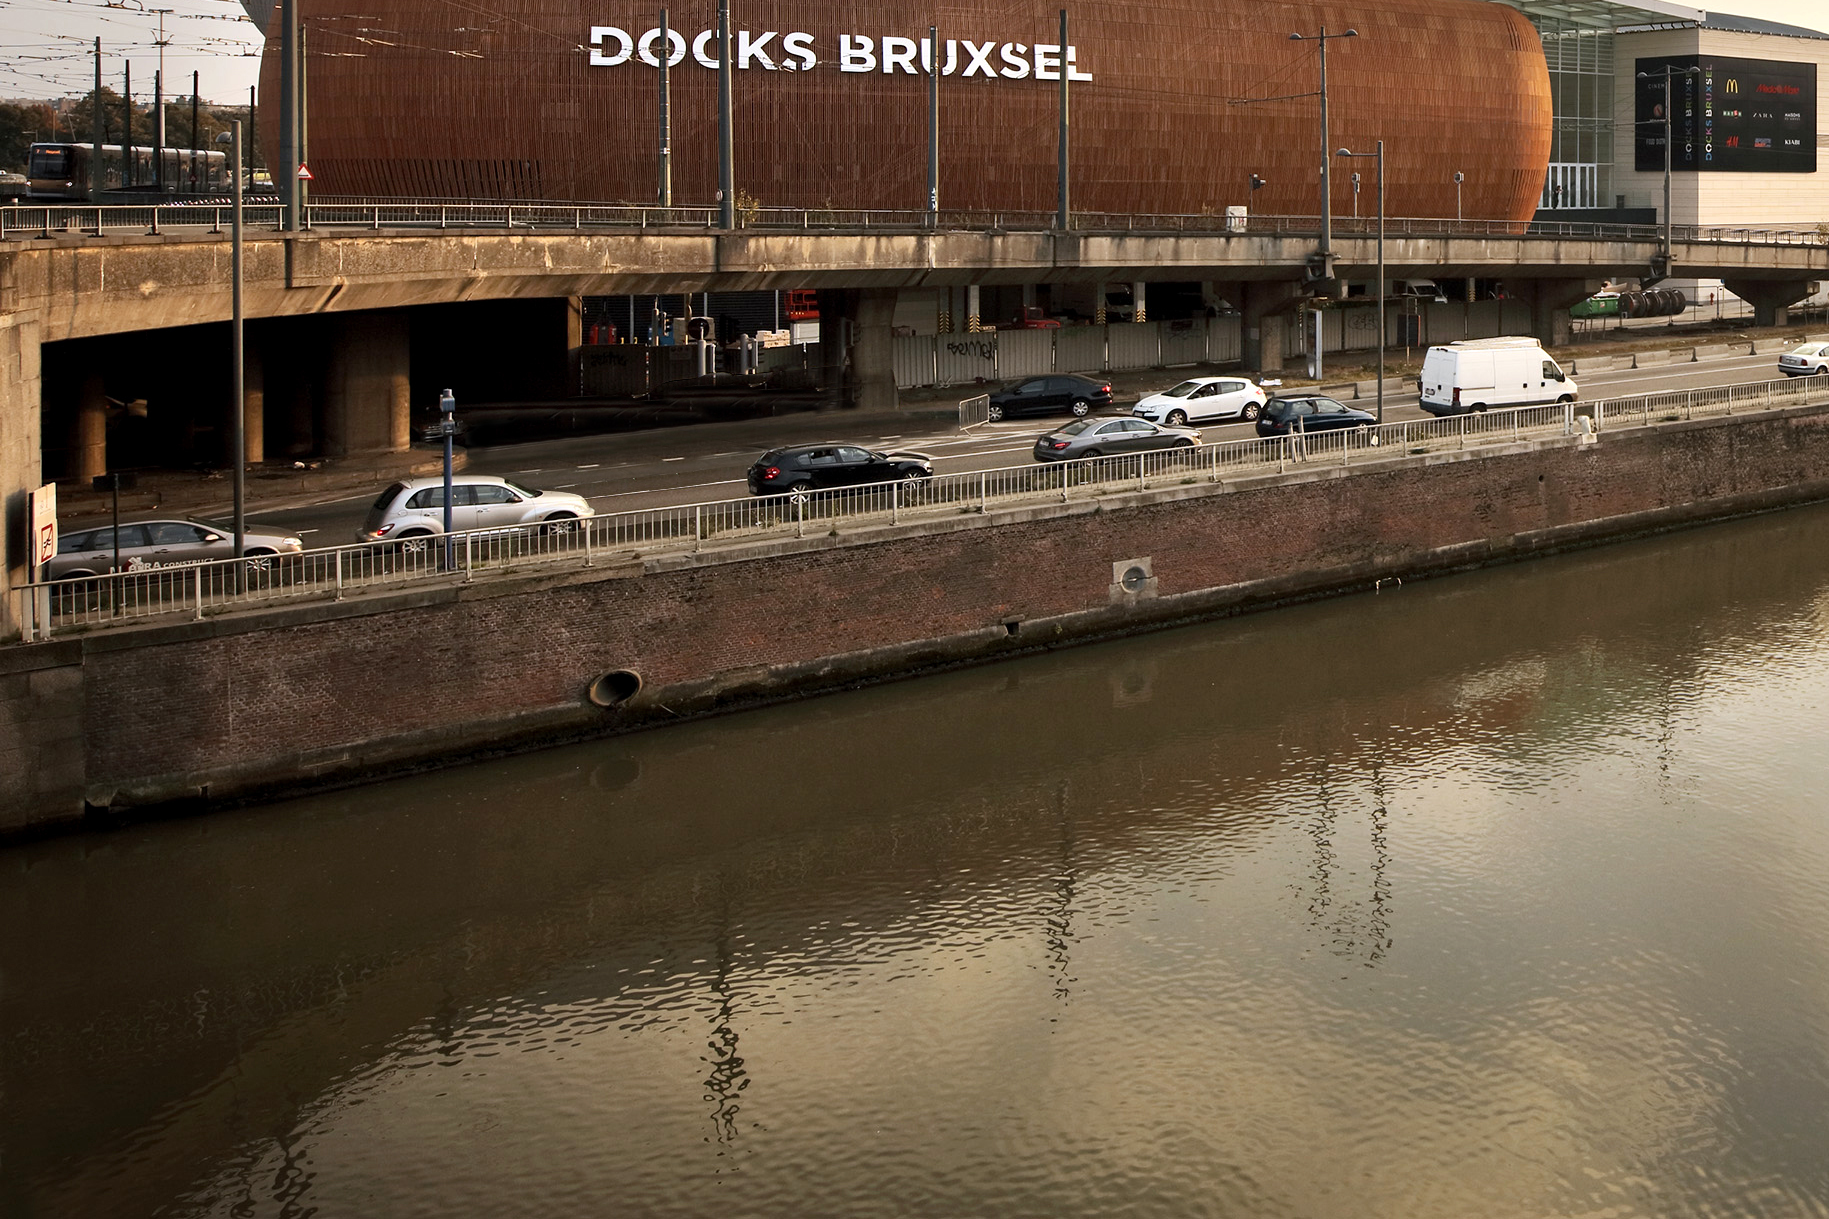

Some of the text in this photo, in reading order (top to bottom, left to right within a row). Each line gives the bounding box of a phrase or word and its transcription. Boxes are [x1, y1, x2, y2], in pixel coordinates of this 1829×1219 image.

[589, 25, 1093, 81] DOCKS BRUXSEL
[1705, 64, 1713, 161] DOCKS BRUXSEL
